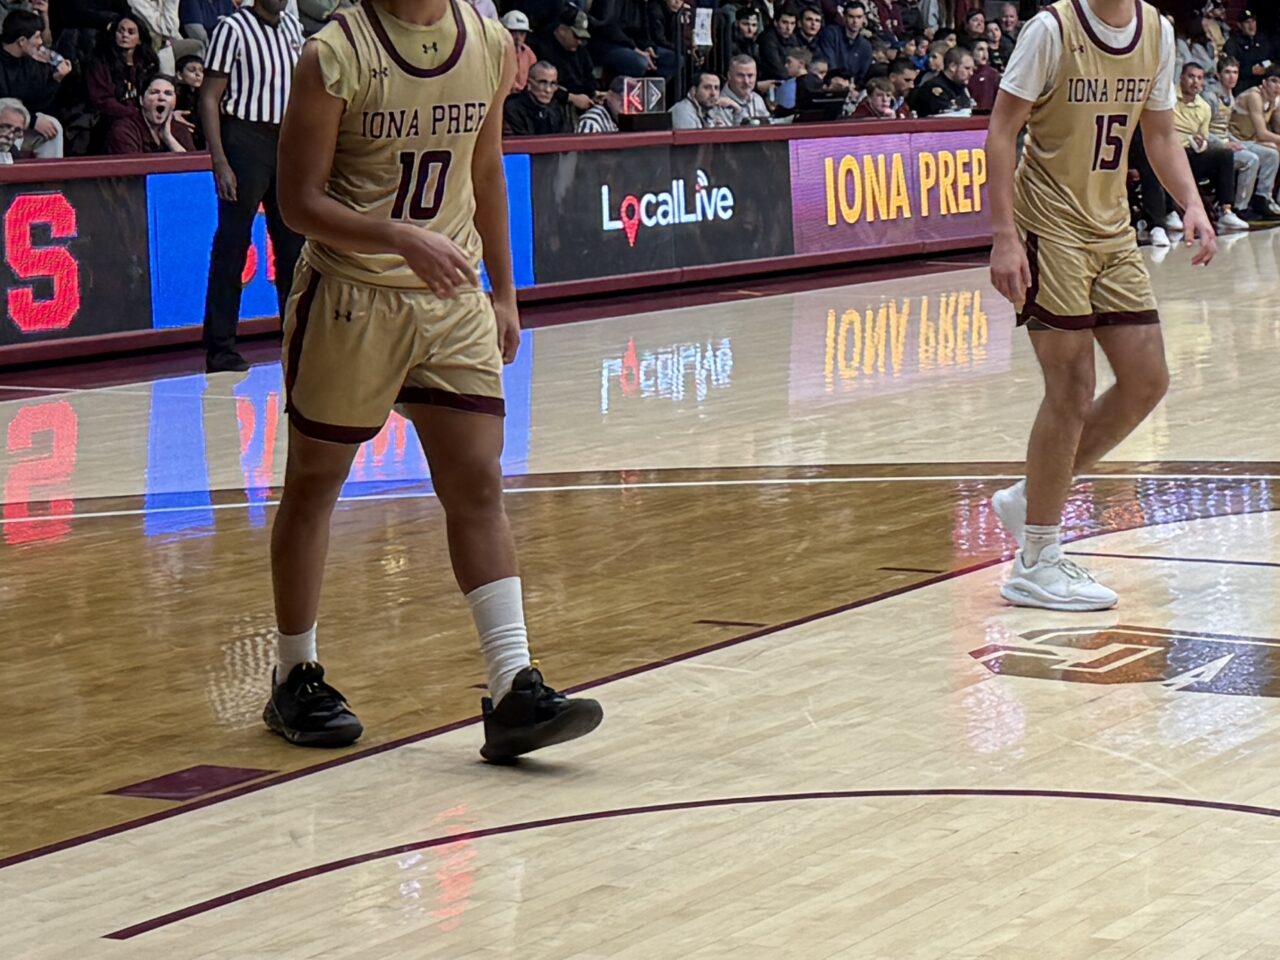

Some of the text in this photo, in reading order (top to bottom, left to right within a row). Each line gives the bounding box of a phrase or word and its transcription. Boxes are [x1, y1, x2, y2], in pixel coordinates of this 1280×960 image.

[360, 109, 420, 139] IONA
[1067, 78, 1150, 103] IONA PRE
[1091, 114, 1128, 172] 15
[390, 150, 452, 221] 10
[601, 170, 735, 246] LocalLive
[823, 148, 987, 227] IONA PREP
[5, 192, 80, 333] S
